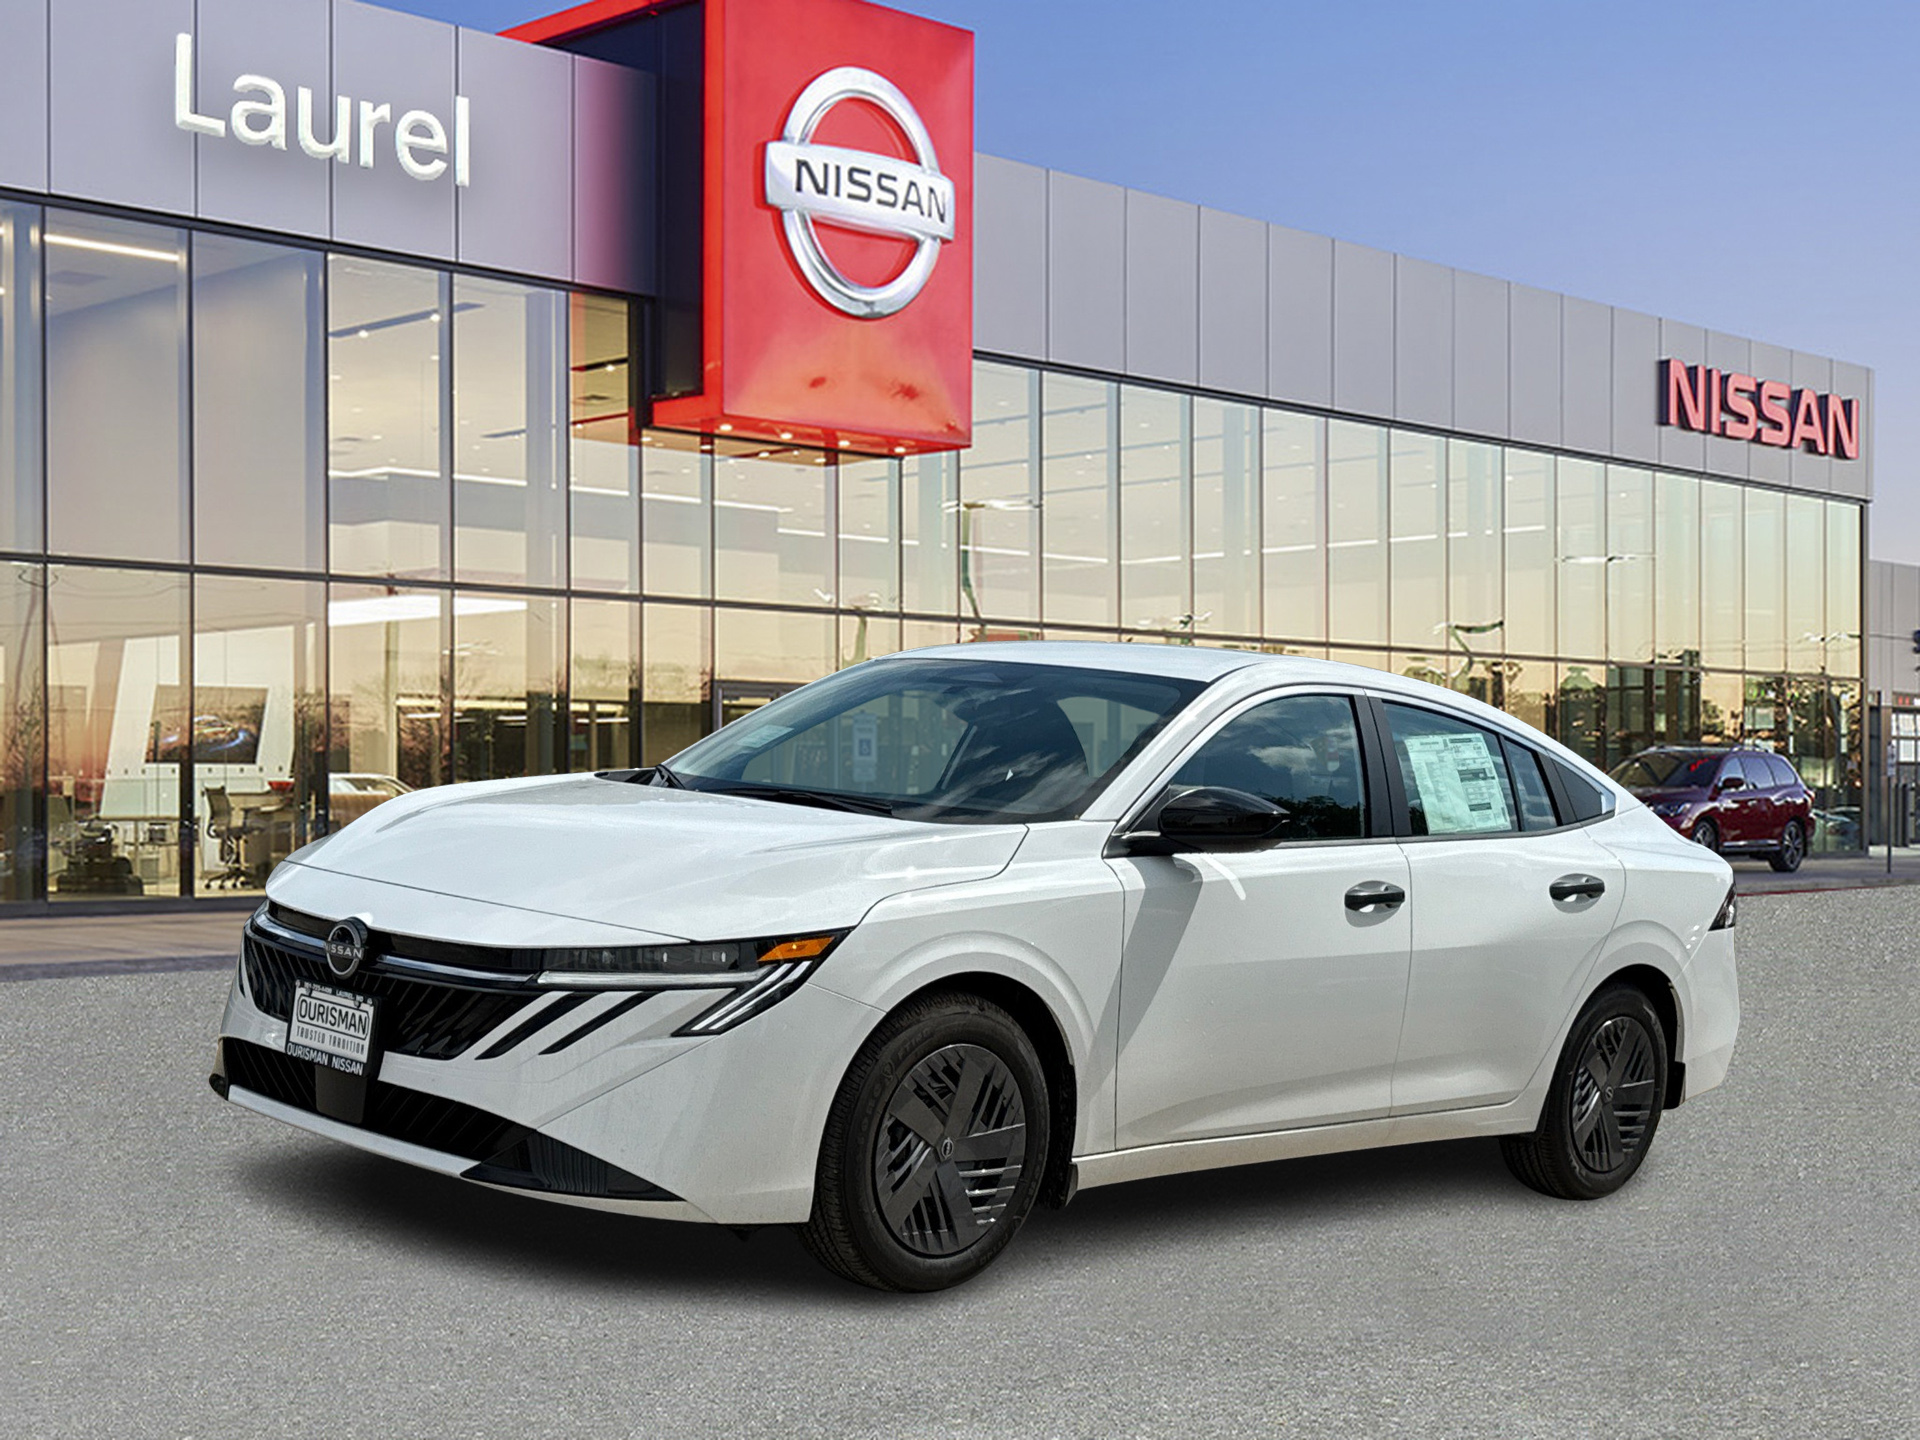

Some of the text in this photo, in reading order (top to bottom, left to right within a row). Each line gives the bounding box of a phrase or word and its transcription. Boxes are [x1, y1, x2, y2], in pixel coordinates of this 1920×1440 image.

[175, 33, 469, 187] Laurel
[795, 158, 946, 223] NISSAN
[1660, 358, 1860, 459] NISSAN
[296, 1025, 326, 1045] TRUSTED
[299, 998, 368, 1036] OURISMAN
[286, 1042, 364, 1077] OURISMAN NISSAN
